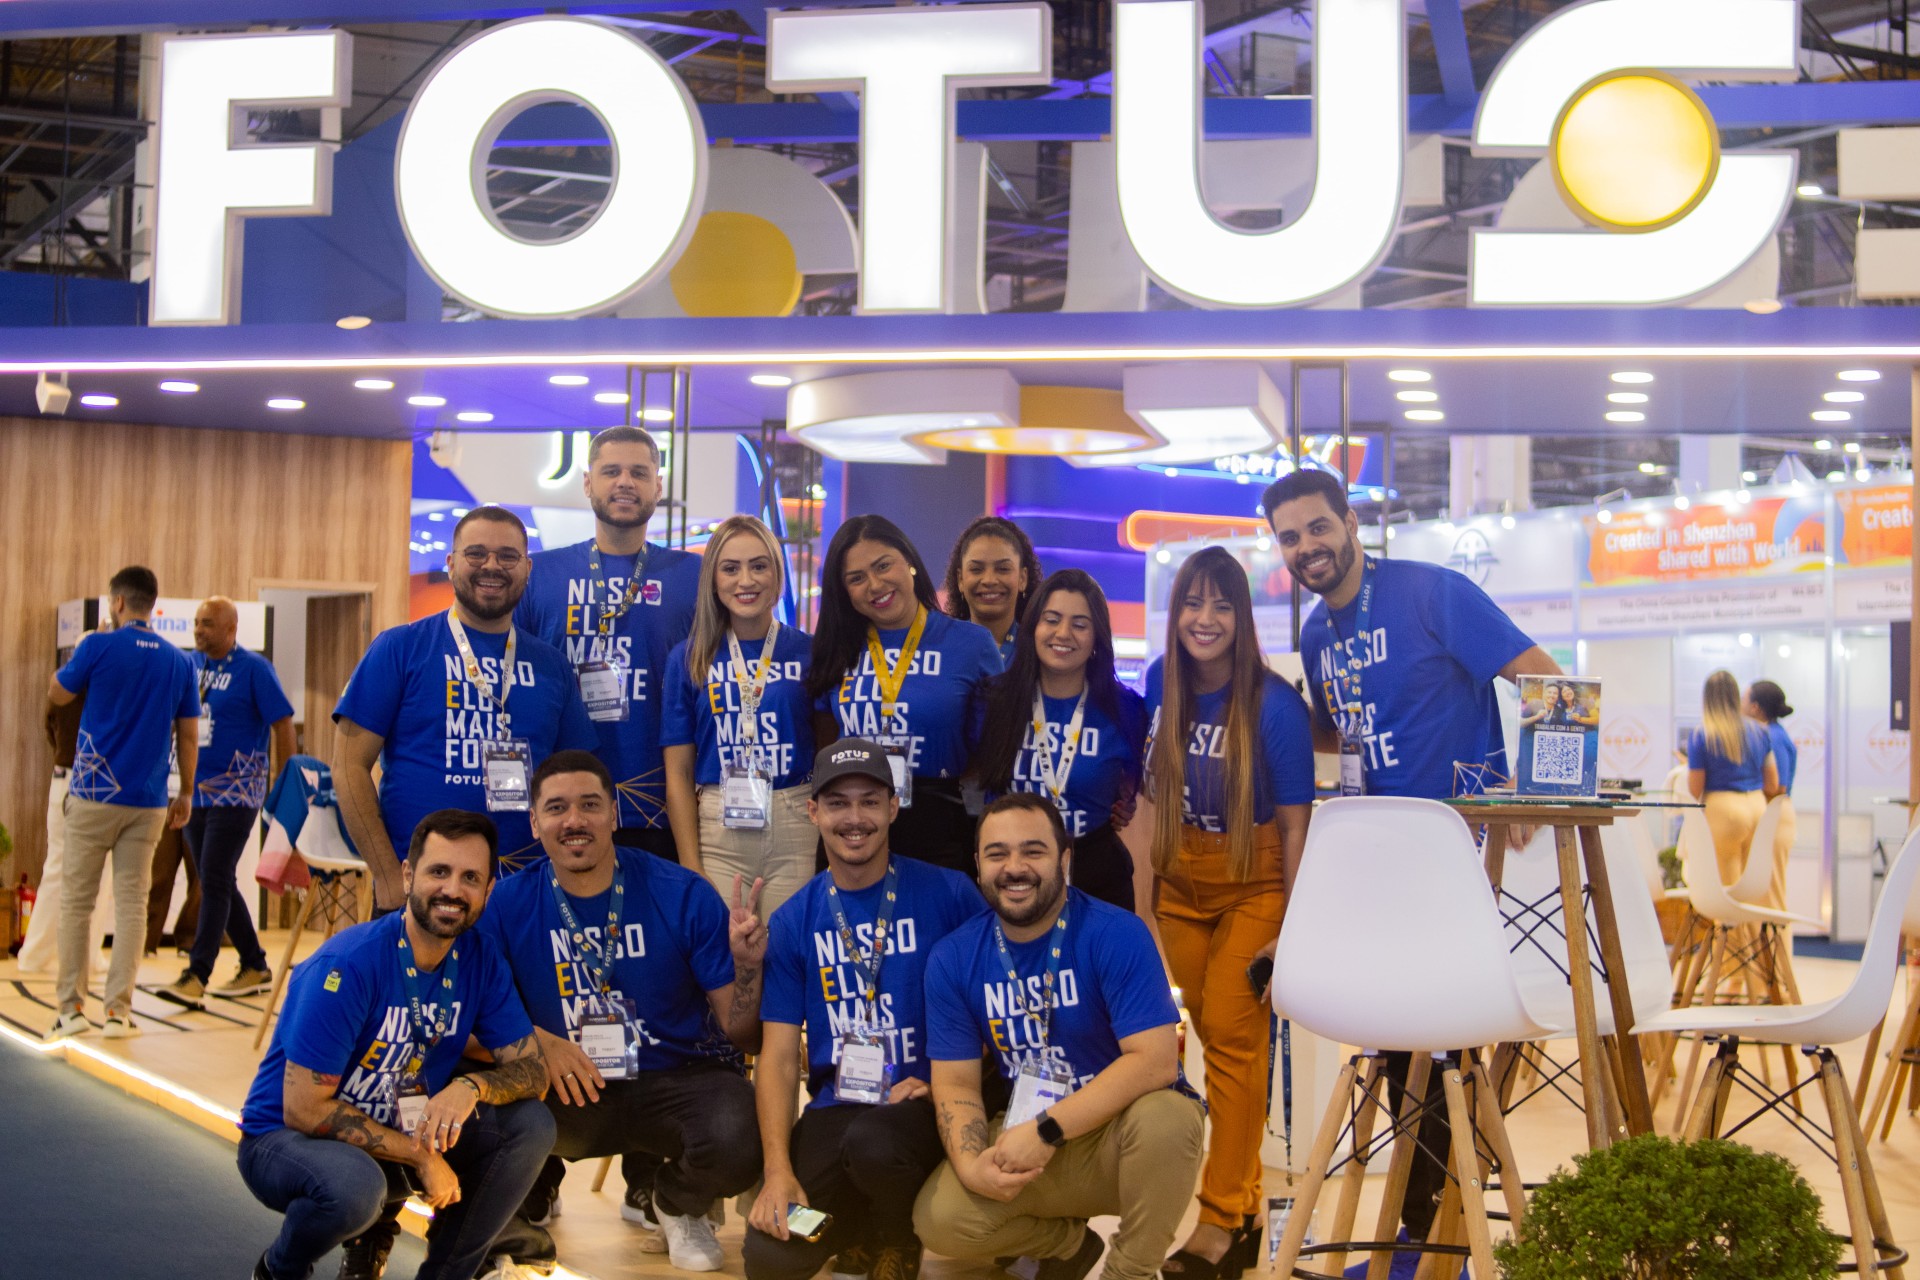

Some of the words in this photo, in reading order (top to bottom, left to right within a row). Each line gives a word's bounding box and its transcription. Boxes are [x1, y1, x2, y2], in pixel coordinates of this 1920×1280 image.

[148, 0, 1799, 326] FOTUS
[1863, 504, 1912, 530] Creat
[1604, 527, 1661, 553] Created
[1665, 527, 1680, 547] in
[1714, 540, 1749, 565] with
[1753, 536, 1801, 564] World
[568, 577, 662, 606] NSO
[566, 636, 632, 667] MAIS
[446, 681, 494, 712] ELO
[708, 682, 757, 714] EL
[1323, 679, 1347, 713] EL
[446, 709, 513, 741] MAIS
[832, 749, 870, 763] FOTUS
[445, 774, 488, 785] FOTUS
[561, 903, 576, 928] FOTUS
[605, 939, 614, 967] FOTUS
[376, 1001, 461, 1043] NOSO
[412, 996, 422, 1026] FOTUS
[989, 1013, 1043, 1052] ELO
[360, 1040, 415, 1073] ELO
